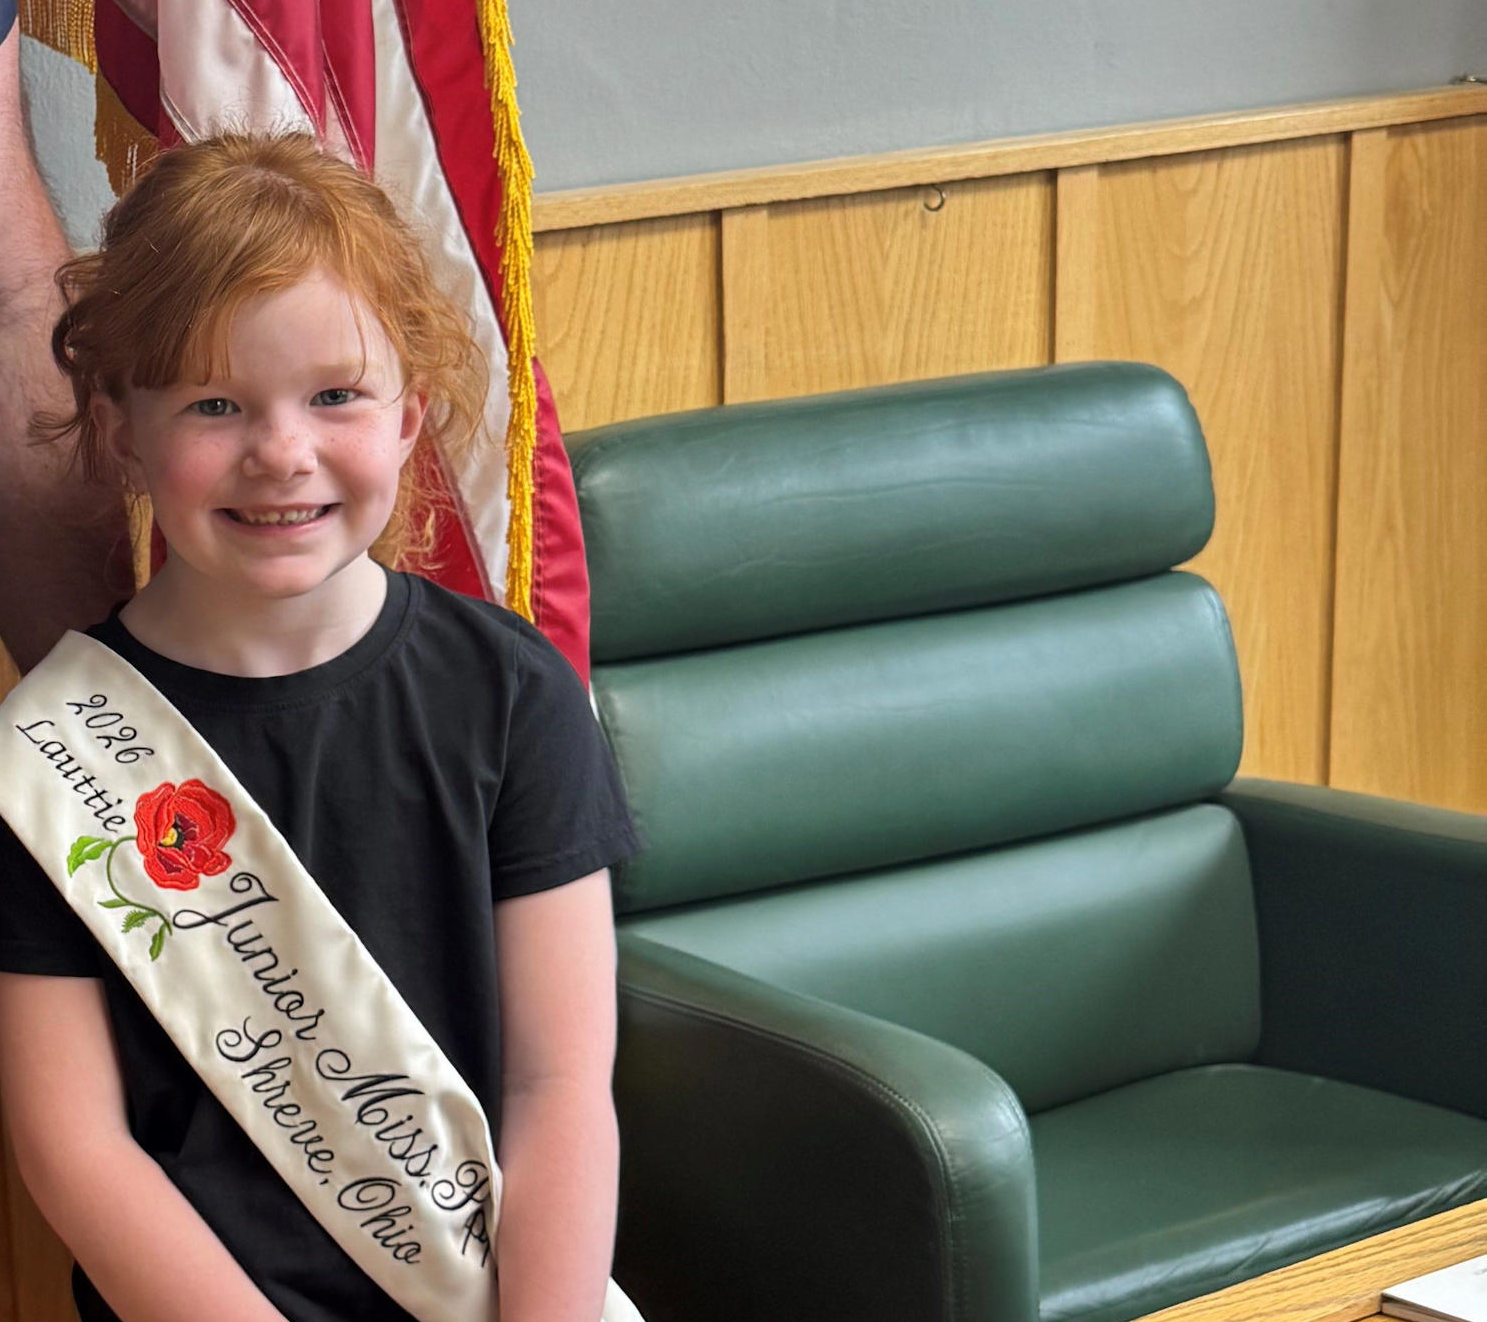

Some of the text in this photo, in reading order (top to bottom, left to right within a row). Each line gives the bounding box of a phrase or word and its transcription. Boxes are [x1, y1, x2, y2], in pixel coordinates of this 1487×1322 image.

[15, 719, 127, 834] Lauttie
[65, 693, 156, 765] 2026
[172, 871, 326, 1041] Junior
[215, 1015, 422, 1265] Shreve, Ohio
